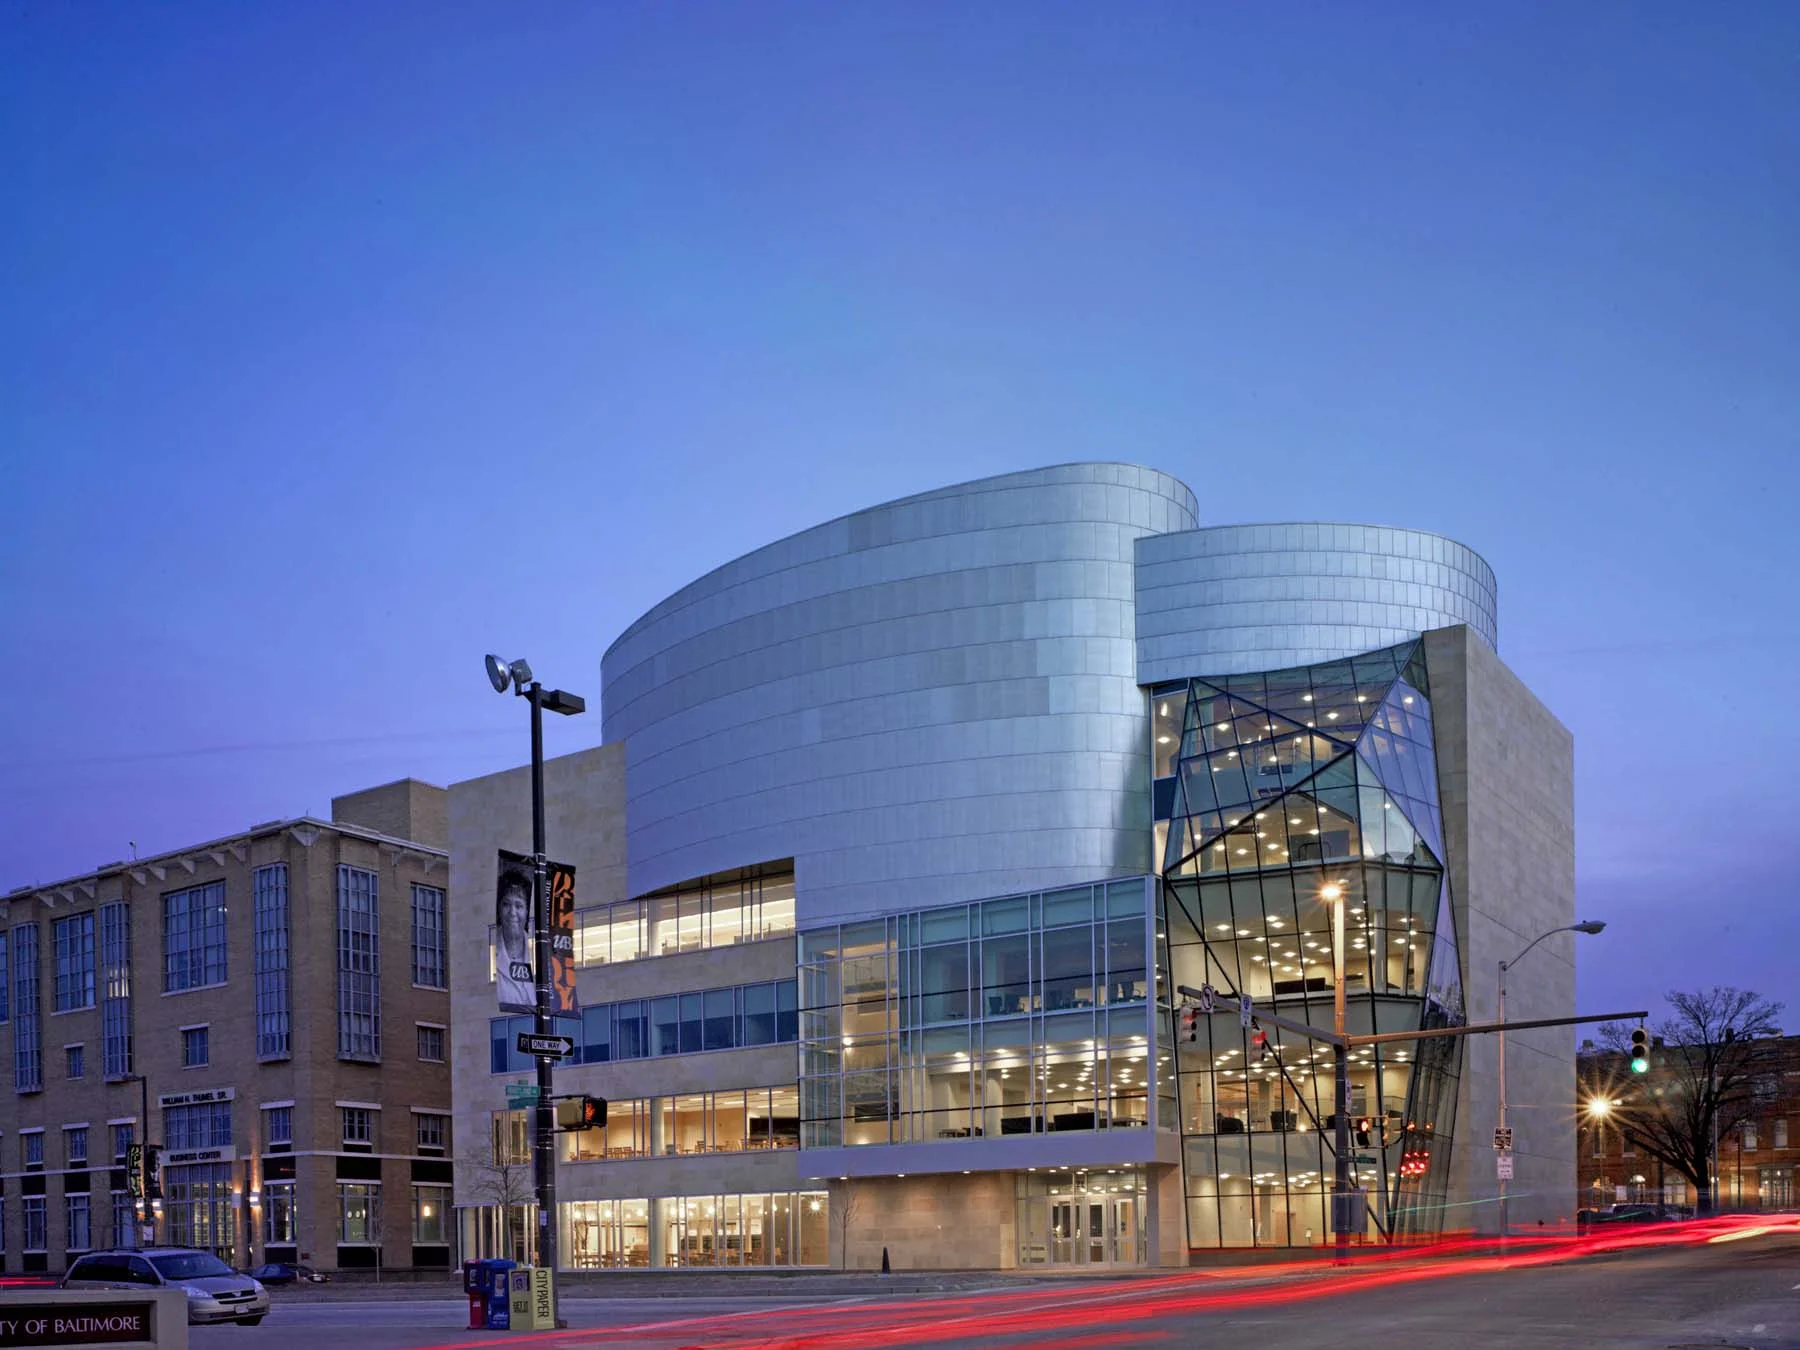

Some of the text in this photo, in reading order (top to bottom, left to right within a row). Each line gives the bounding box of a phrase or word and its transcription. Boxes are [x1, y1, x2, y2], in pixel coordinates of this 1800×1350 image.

[511, 964, 530, 979] UB
[532, 1040, 560, 1050] ONE WAY
[169, 1151, 221, 1162] BUSINESS CENTER
[25, 1320, 48, 1335] OF
[54, 1316, 141, 1334] BALTIMORE
